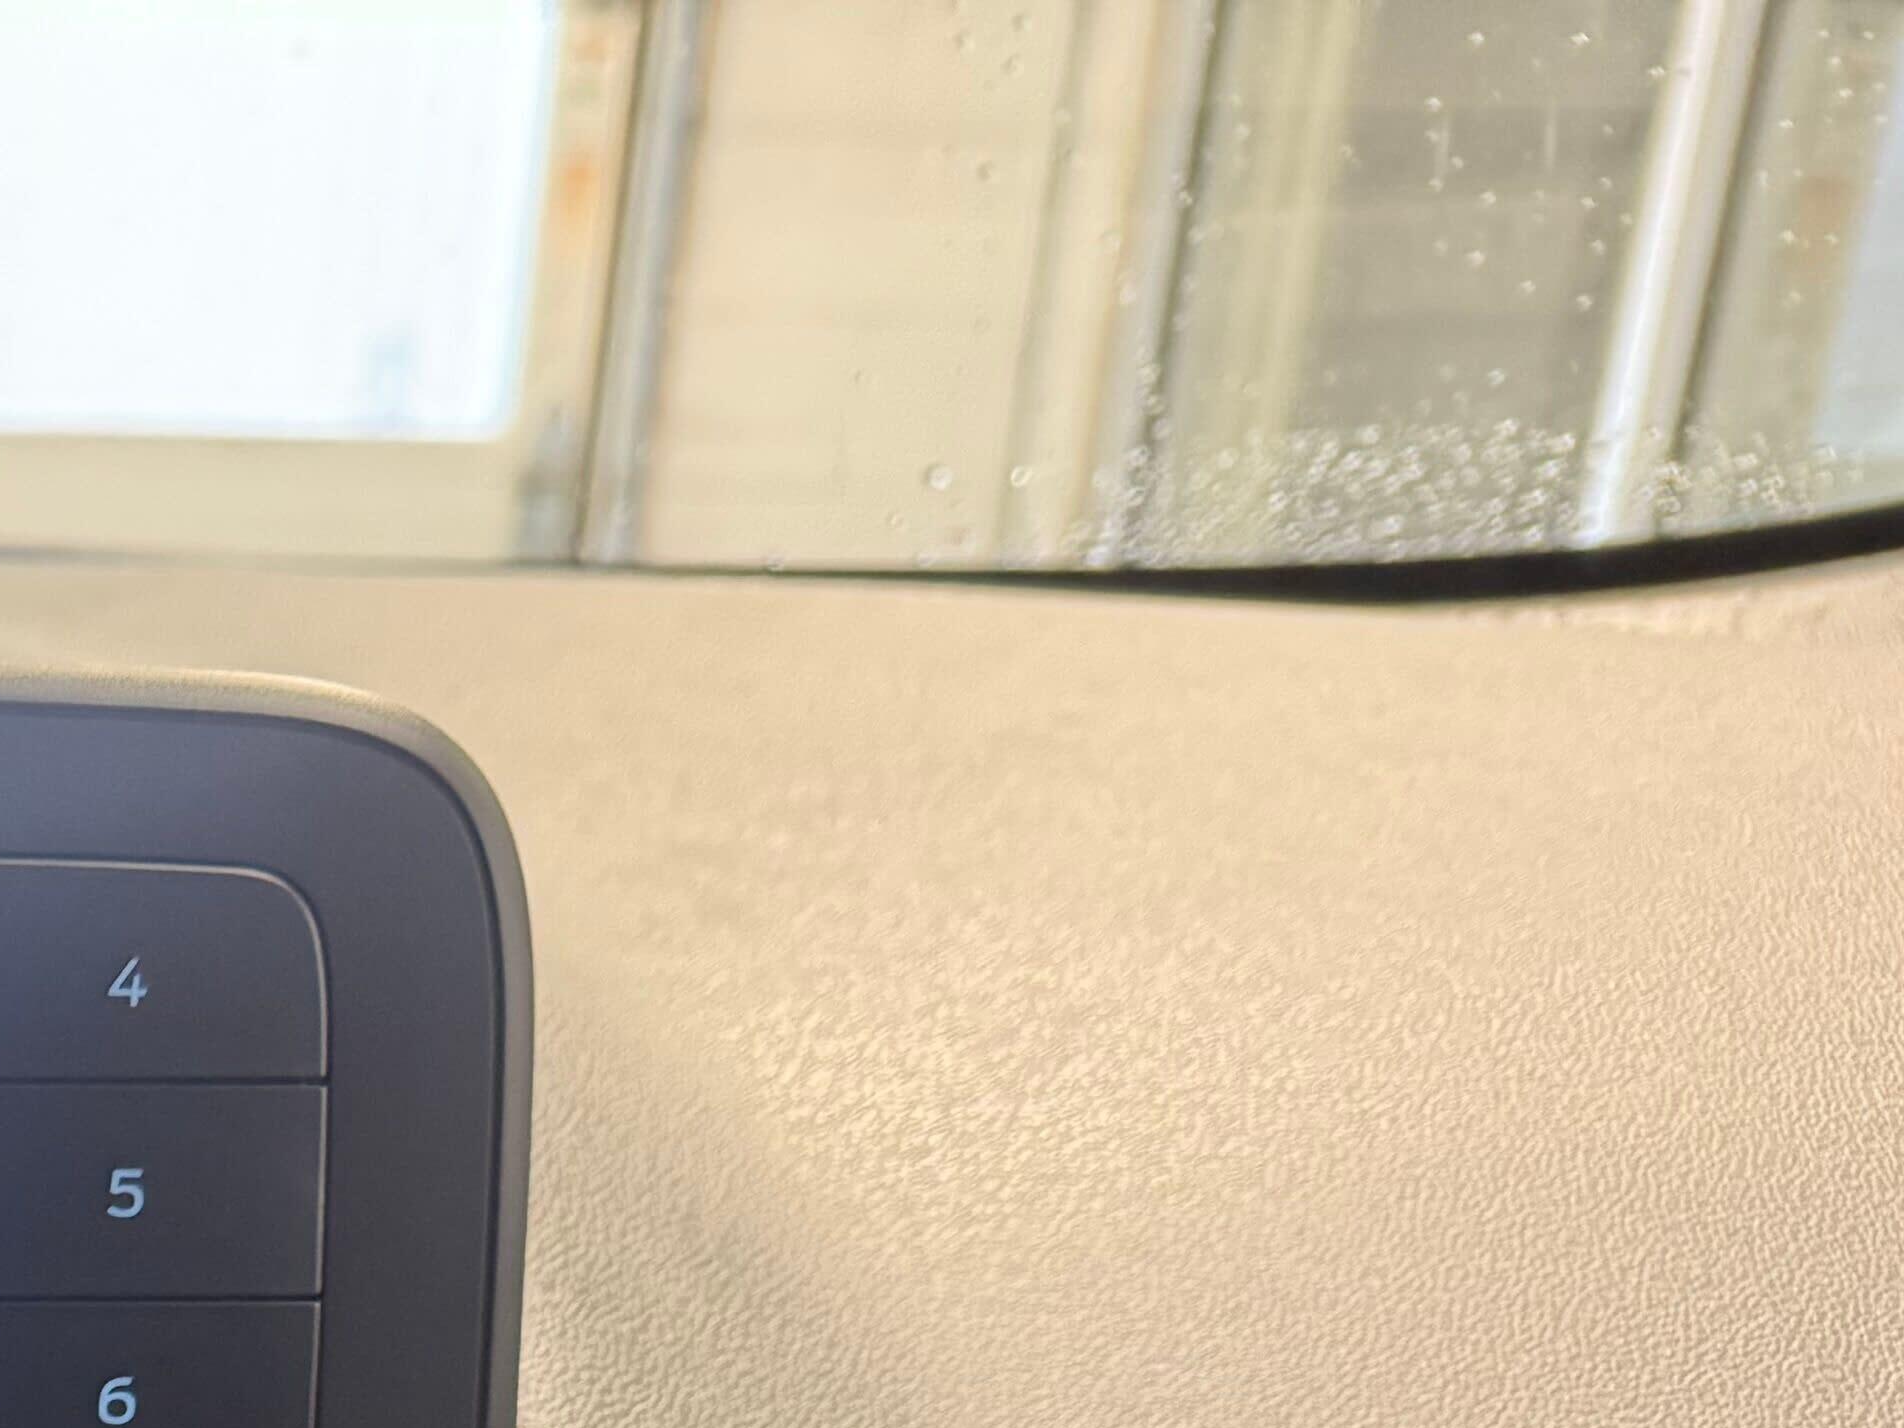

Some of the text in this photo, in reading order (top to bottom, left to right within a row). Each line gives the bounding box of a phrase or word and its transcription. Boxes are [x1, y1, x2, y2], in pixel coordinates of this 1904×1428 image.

[107, 958, 149, 1009] 4
[106, 1168, 146, 1218] 5
[97, 1376, 137, 1426] 6
